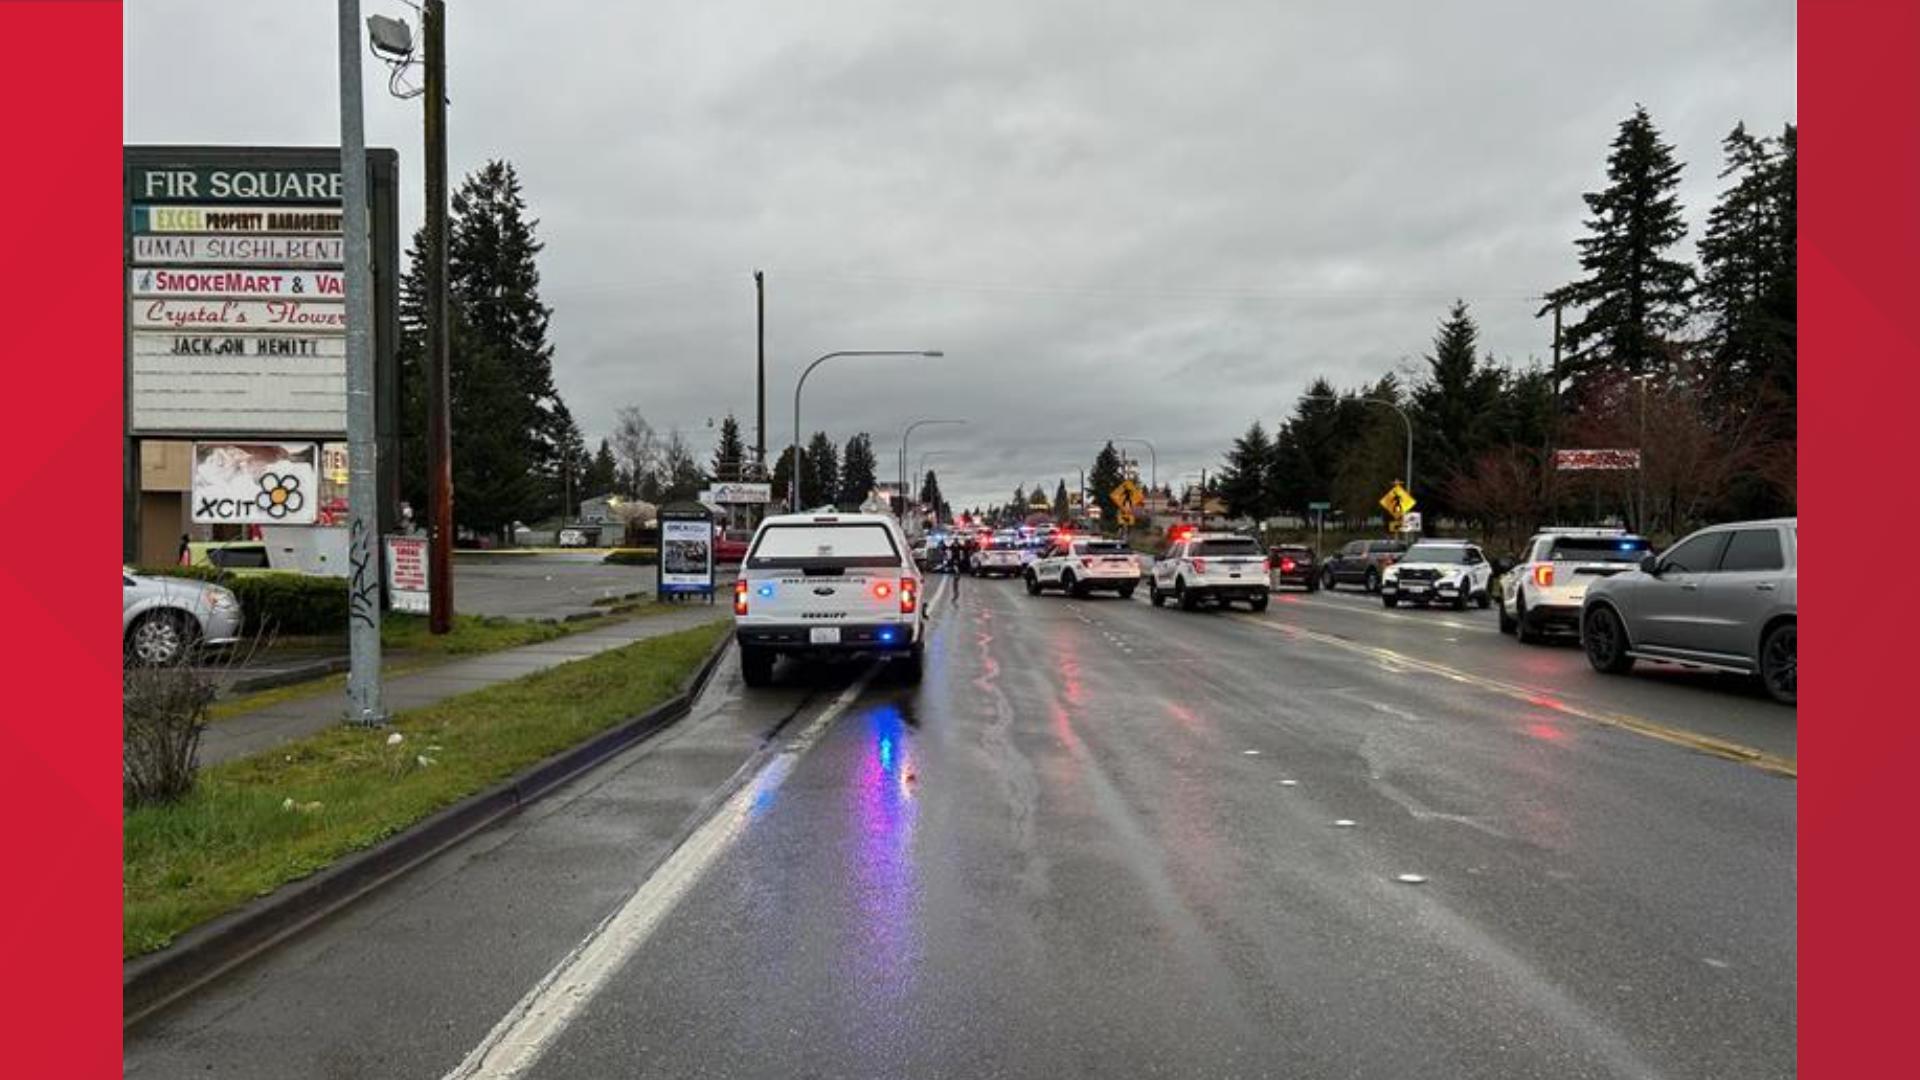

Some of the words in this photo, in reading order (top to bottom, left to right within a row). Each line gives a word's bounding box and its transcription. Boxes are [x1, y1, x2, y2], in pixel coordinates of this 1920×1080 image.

[145, 171, 198, 198] FIR
[210, 171, 344, 199] SQUARE
[157, 210, 203, 230] EXCEL
[206, 212, 263, 231] PROPERTY
[138, 238, 195, 258] UMAI
[292, 276, 304, 294] &
[315, 274, 345, 294] VA
[147, 299, 248, 326] Crystal's
[195, 496, 256, 518] XCIT
